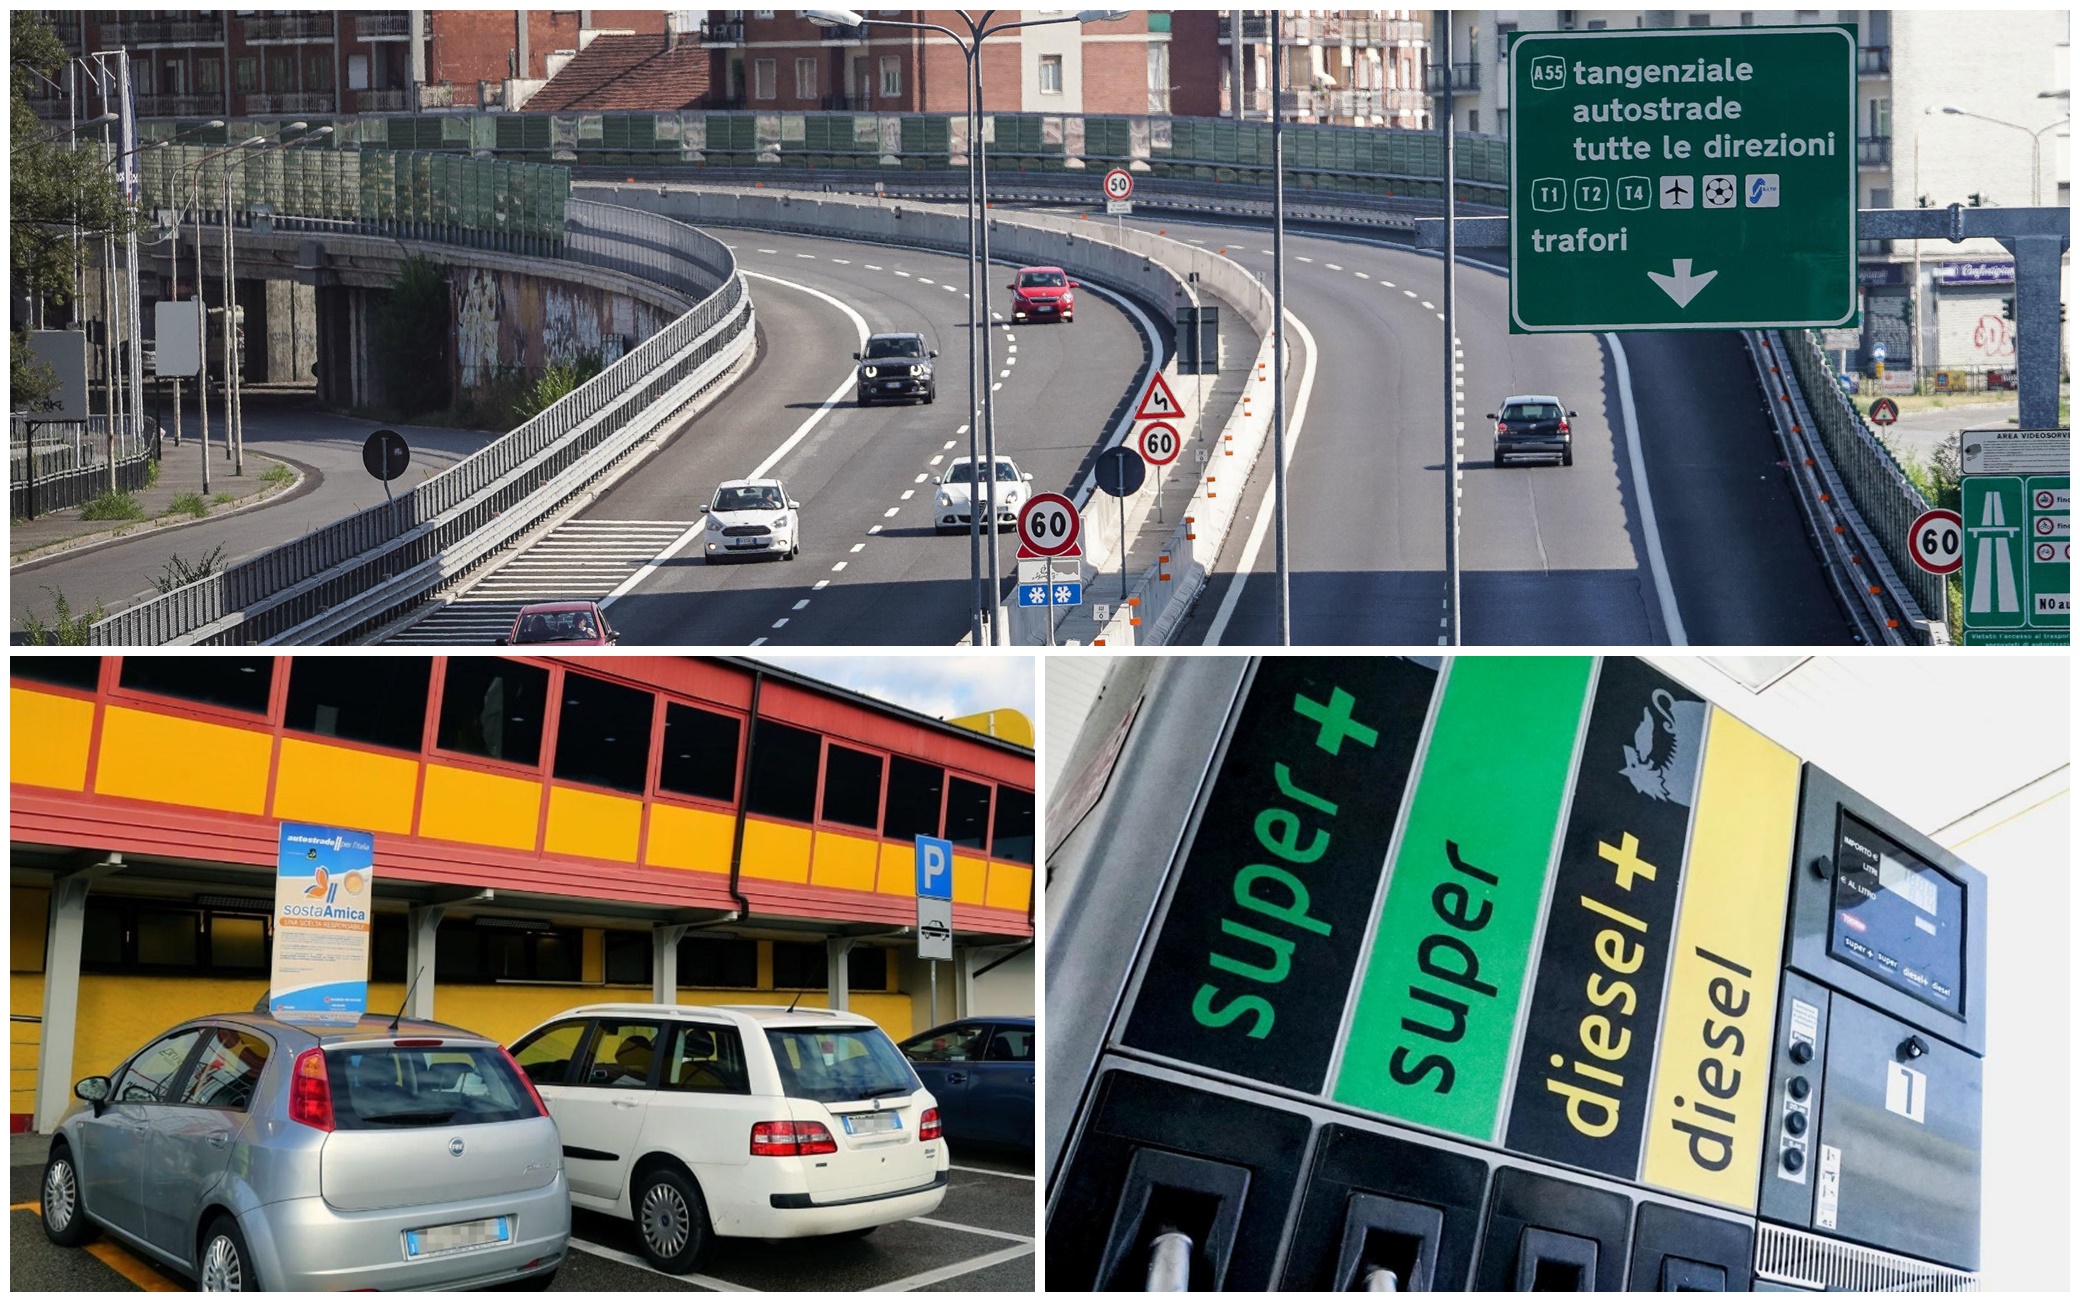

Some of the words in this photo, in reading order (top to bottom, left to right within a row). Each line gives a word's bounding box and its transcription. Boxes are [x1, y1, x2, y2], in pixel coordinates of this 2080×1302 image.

[1534, 65, 1563, 81] A55
[1573, 57, 1754, 88] tangenziale
[1572, 96, 1742, 123] autostrade
[1573, 136, 1651, 161] tutte
[1663, 135, 1691, 159] le
[1703, 131, 1836, 159] direzioni
[1110, 178, 1126, 192] 50
[1541, 187, 1557, 202] T1
[1582, 186, 1601, 201] T2
[1625, 185, 1644, 200] T4
[1531, 227, 1628, 252] trafori
[1147, 433, 1172, 454] 60
[1031, 511, 1067, 538] 60
[1922, 529, 1959, 555] 60
[2039, 598, 2056, 610] NO
[924, 844, 945, 889] P
[283, 904, 366, 921] sostaAmica
[1190, 762, 1338, 1040] super
[300, 920, 323, 928] SCELTA
[1845, 937, 1867, 954] super
[1389, 839, 1499, 1094] super
[1878, 953, 1898, 968] super
[1547, 894, 1649, 1139] diesel
[1671, 946, 1752, 1174] diesel
